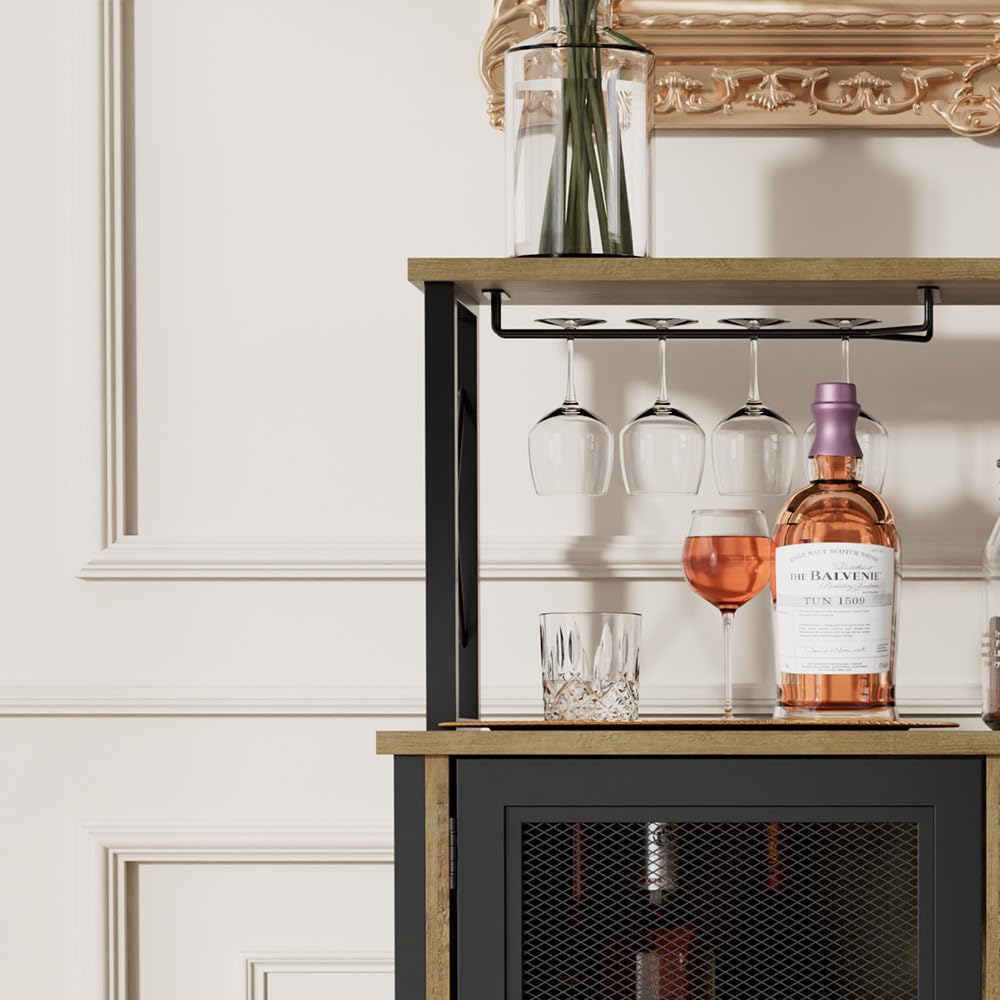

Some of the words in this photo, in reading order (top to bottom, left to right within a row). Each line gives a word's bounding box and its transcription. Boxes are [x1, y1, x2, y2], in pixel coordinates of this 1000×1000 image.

[790, 572, 805, 581] THE
[811, 570, 880, 581] BALVENIE
[803, 596, 832, 606] TUN
[839, 596, 865, 606] 1509
